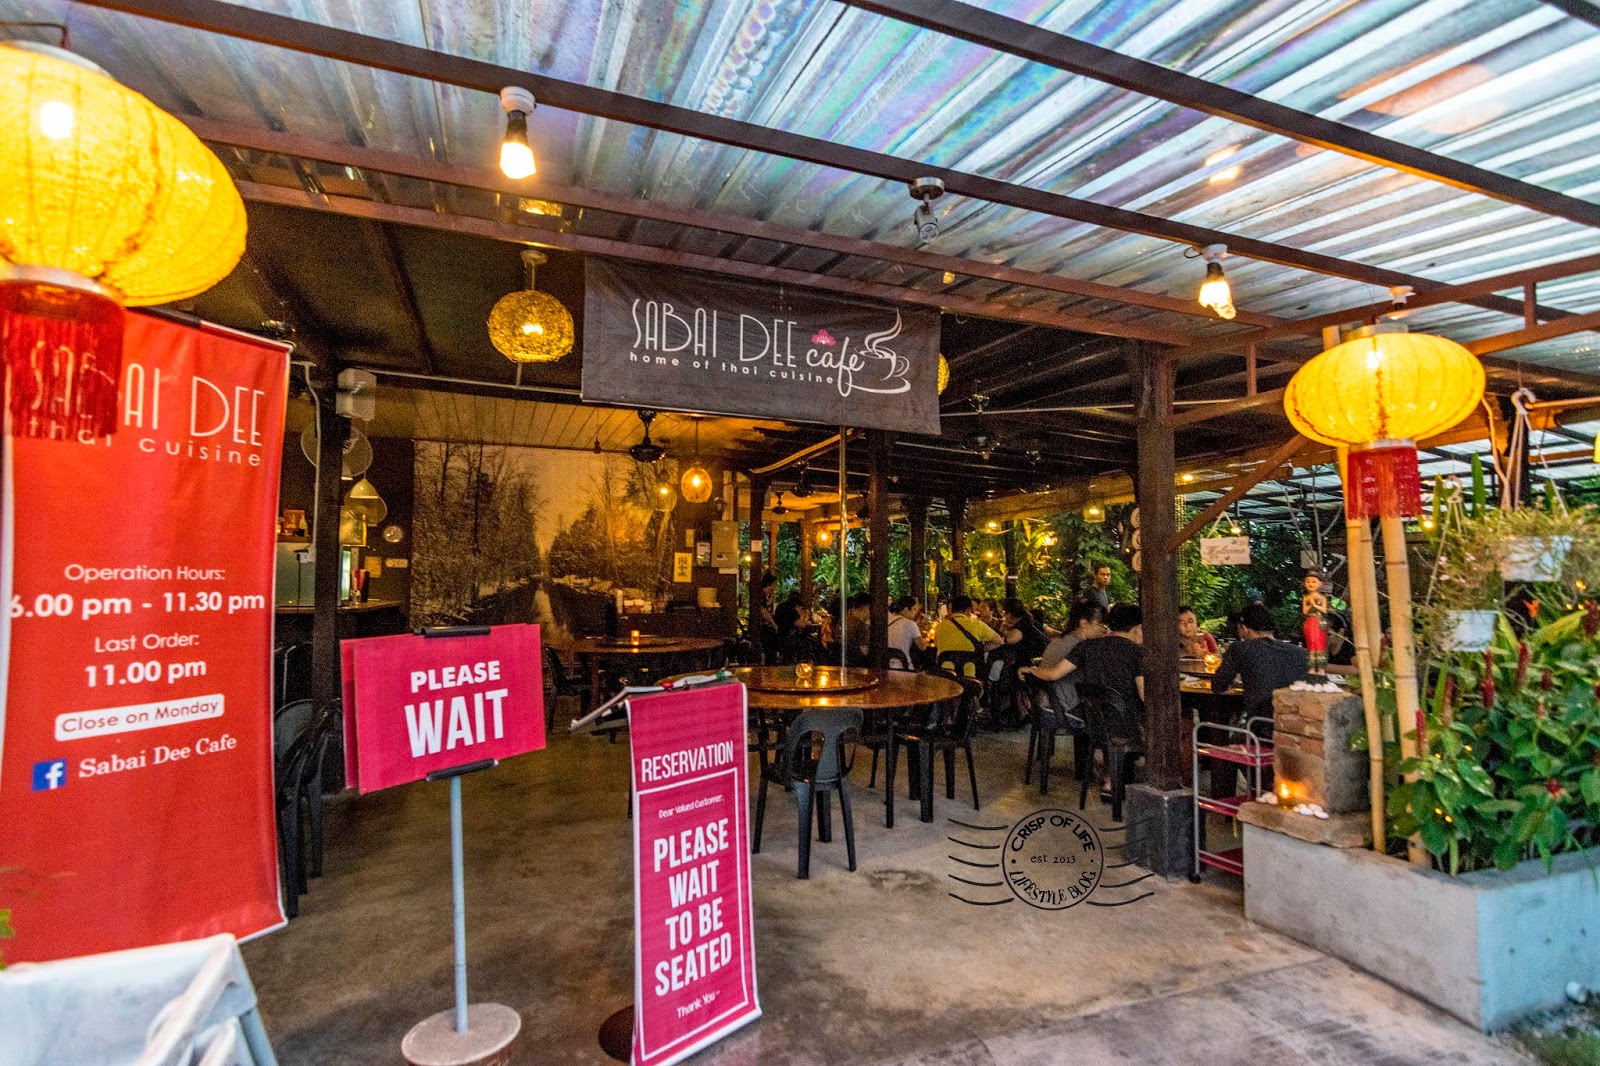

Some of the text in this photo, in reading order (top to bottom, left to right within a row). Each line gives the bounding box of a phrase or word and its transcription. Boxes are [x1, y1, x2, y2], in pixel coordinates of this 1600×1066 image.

[631, 298, 866, 398] SABAI DEE cafe
[629, 351, 833, 385] home of thai cuisine
[190, 375, 266, 447] DEE
[139, 437, 262, 467] cuisine
[64, 563, 226, 584] Operation Hours:
[82, 596, 132, 621] pm
[163, 591, 222, 612] 11.30
[228, 594, 265, 615] pm
[94, 634, 137, 653] Last
[85, 660, 207, 688] 11.00 pm
[410, 659, 501, 694] PLEASE
[61, 699, 220, 734] Close on Monday
[404, 688, 509, 759] WAIT
[78, 734, 238, 778] Sabai Dee Cafe
[641, 740, 734, 783] RESERVATION
[658, 807, 675, 819] Dear
[674, 801, 695, 814] Valued
[653, 818, 729, 873] PLEASE
[668, 859, 720, 909] WAIT
[665, 896, 724, 951] TO BE
[655, 931, 732, 997] SEATED
[676, 998, 703, 1019] Thank
